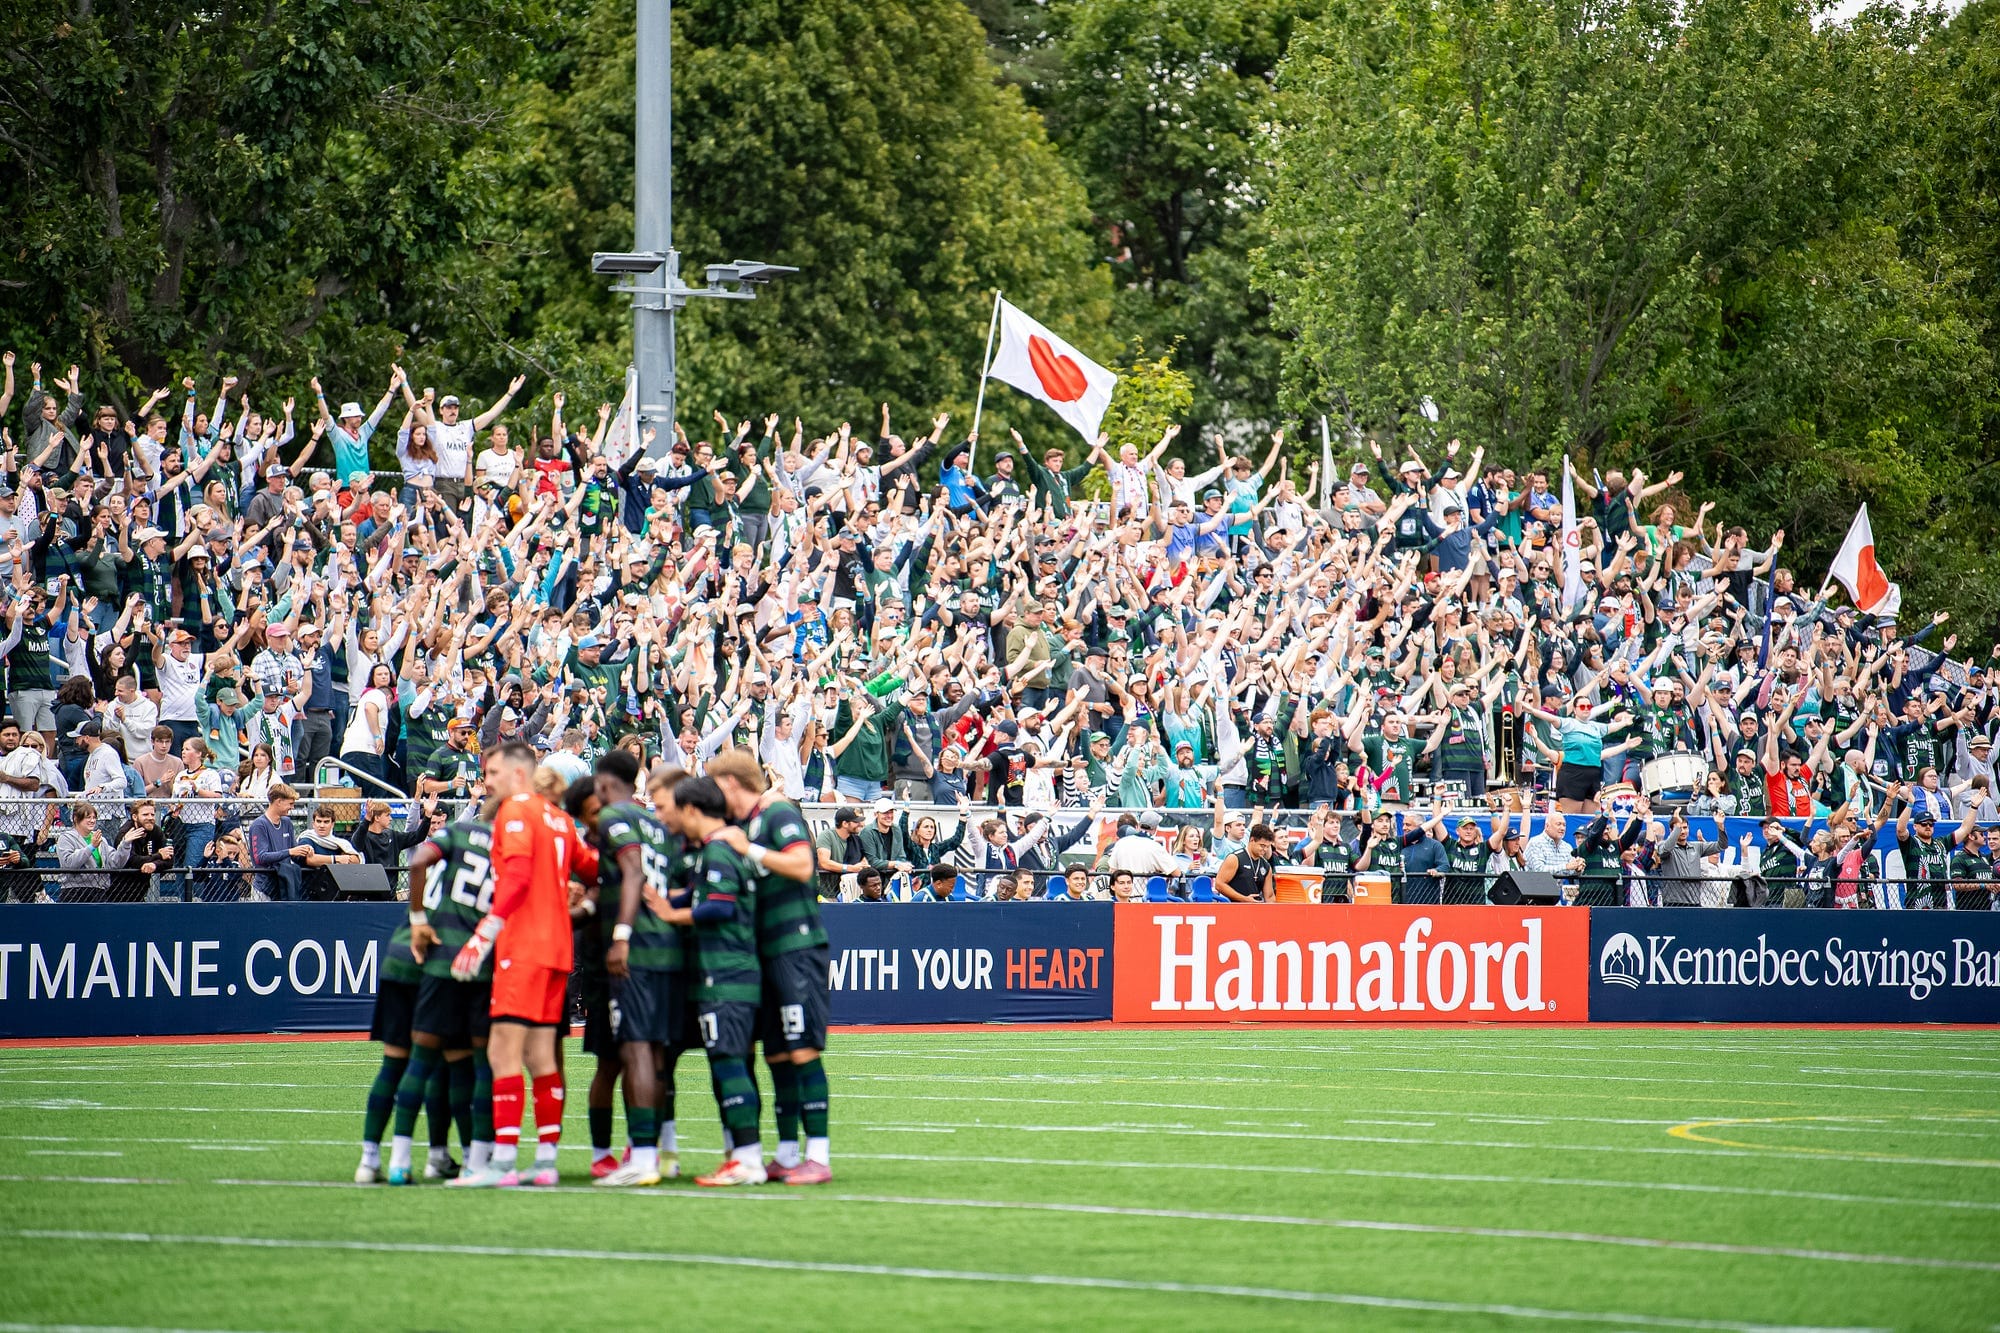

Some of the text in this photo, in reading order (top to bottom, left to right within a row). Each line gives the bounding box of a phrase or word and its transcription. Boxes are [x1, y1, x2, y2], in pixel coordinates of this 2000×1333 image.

[1323, 861, 1348, 873] MAINE
[911, 948, 994, 991] YOUR
[1006, 948, 1105, 990] HEART
[1151, 915, 1546, 1012] Hannaford
[1646, 933, 1820, 986] Kennebec
[1825, 937, 1947, 1001] Savings
